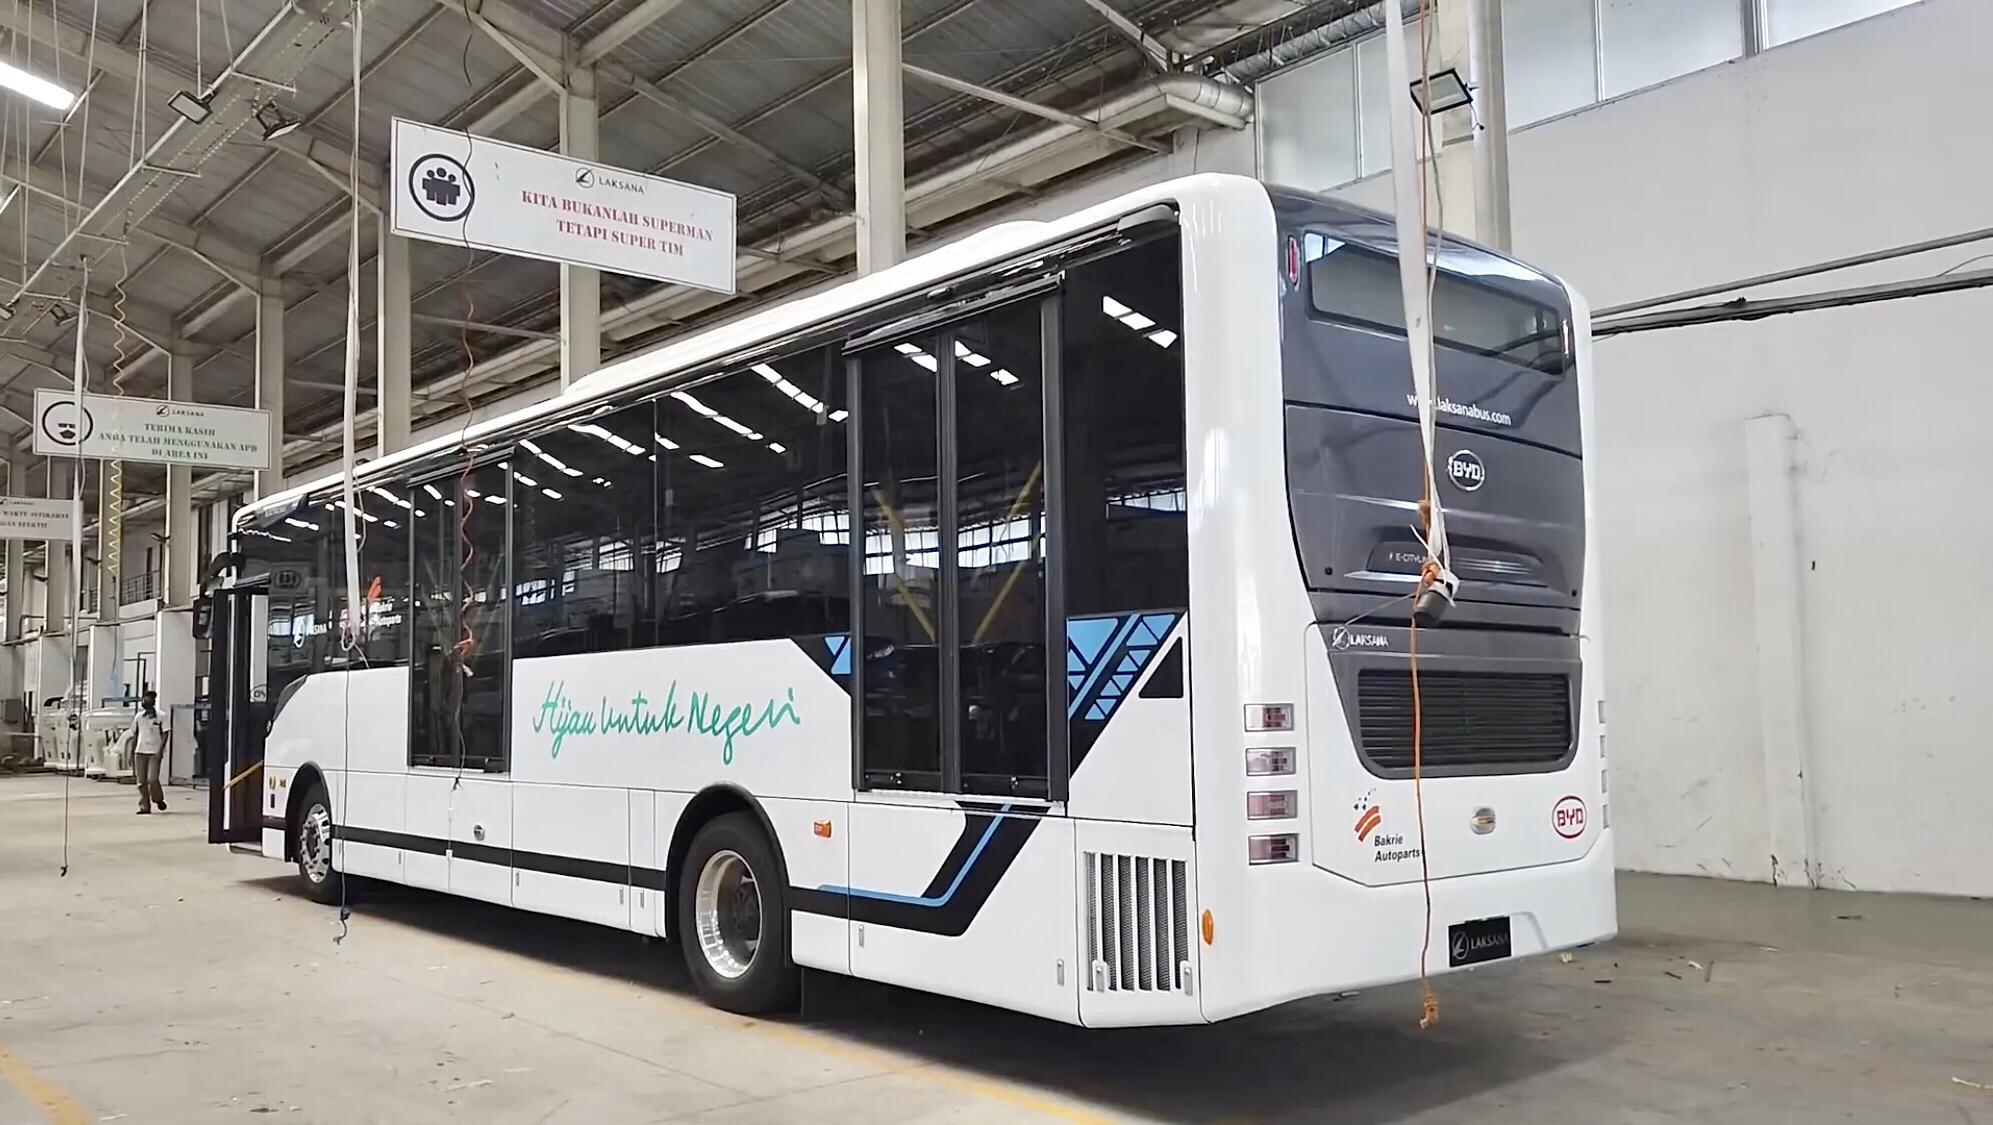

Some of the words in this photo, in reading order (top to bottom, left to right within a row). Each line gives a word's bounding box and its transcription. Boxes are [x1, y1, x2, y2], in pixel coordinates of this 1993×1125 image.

[598, 176, 645, 195] LAKSANA
[521, 190, 557, 209] KITA
[562, 197, 639, 225] BUKANLAH
[642, 215, 714, 242] SUPERMAN
[557, 221, 608, 240] TETAPI
[611, 228, 656, 251] SUPER
[661, 239, 684, 256] TIM
[1407, 394, 1512, 426] w.laksanabus.com
[144, 423, 183, 434] TERIMA
[185, 427, 216, 436] KASIH
[99, 433, 126, 442] ANDA
[129, 435, 161, 444] TELAH
[163, 438, 237, 450] MENGGUNAKAN
[239, 444, 259, 452] APD
[166, 450, 191, 458] AREA
[1453, 460, 1481, 480] BYD
[1349, 630, 1389, 646] LAKSANA
[600, 679, 684, 735] Untuk
[687, 687, 801, 765] Negeri
[1557, 806, 1583, 827] BYD
[1374, 834, 1404, 847] Bakrie
[1374, 848, 1421, 862] Autoparts
[1470, 932, 1509, 950] LAKSANA
